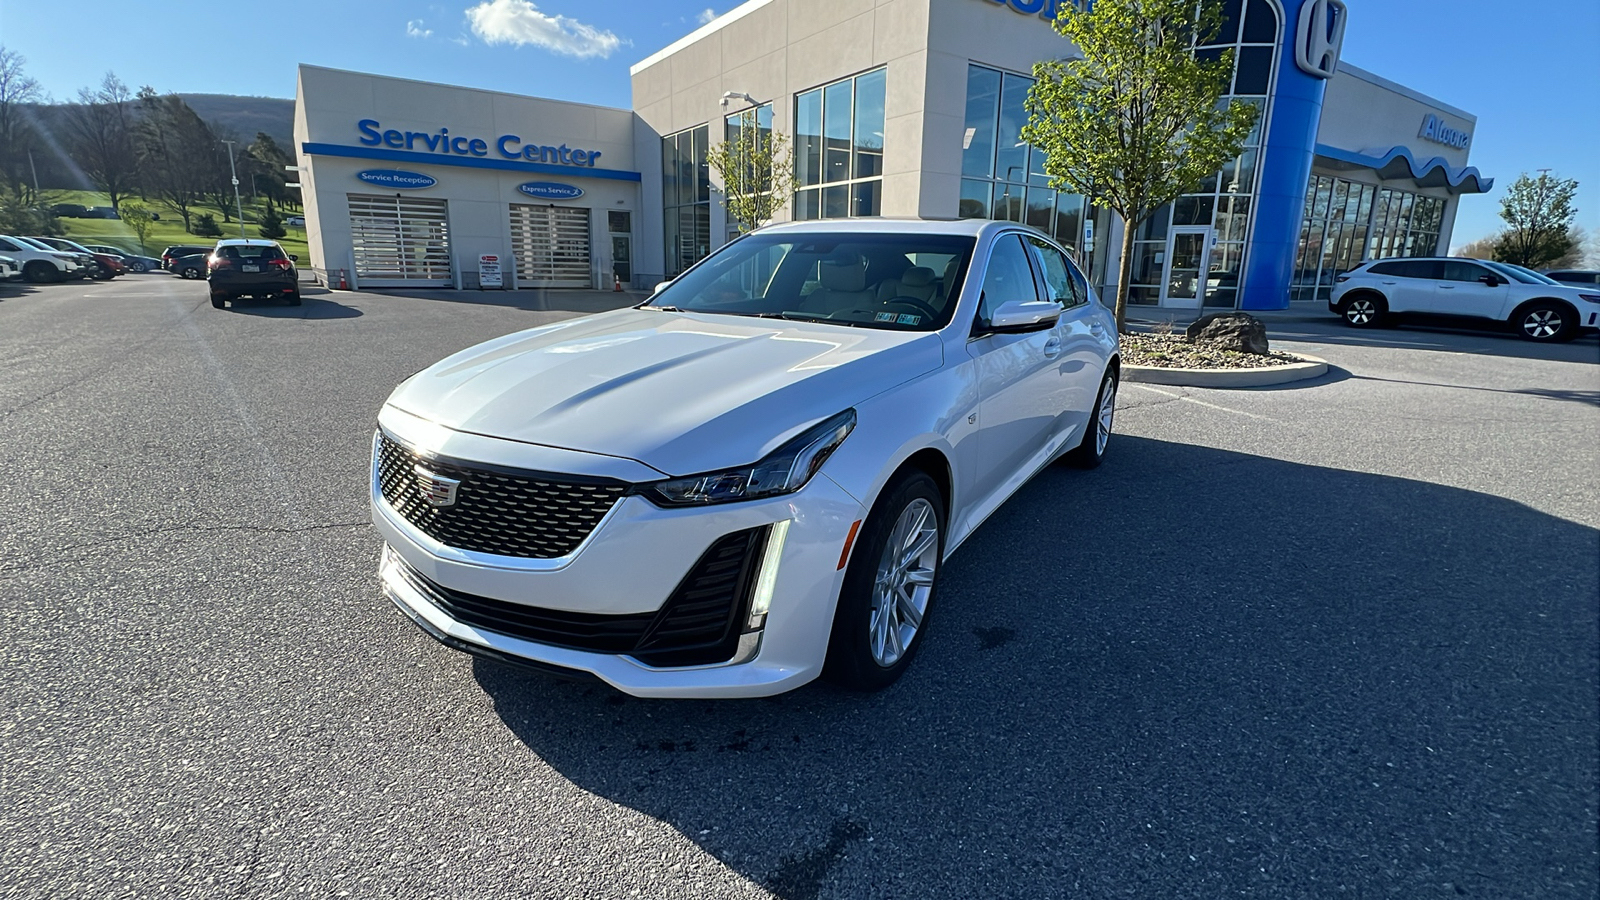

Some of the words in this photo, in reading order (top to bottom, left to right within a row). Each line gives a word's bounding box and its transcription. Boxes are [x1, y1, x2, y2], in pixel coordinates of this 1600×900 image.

[358, 118, 488, 156] Service
[497, 134, 602, 167] Center
[1421, 112, 1469, 150] Altoona
[361, 172, 392, 182] Service
[393, 175, 433, 185] Reception
[522, 185, 547, 194] Express
[547, 187, 571, 195] Service
